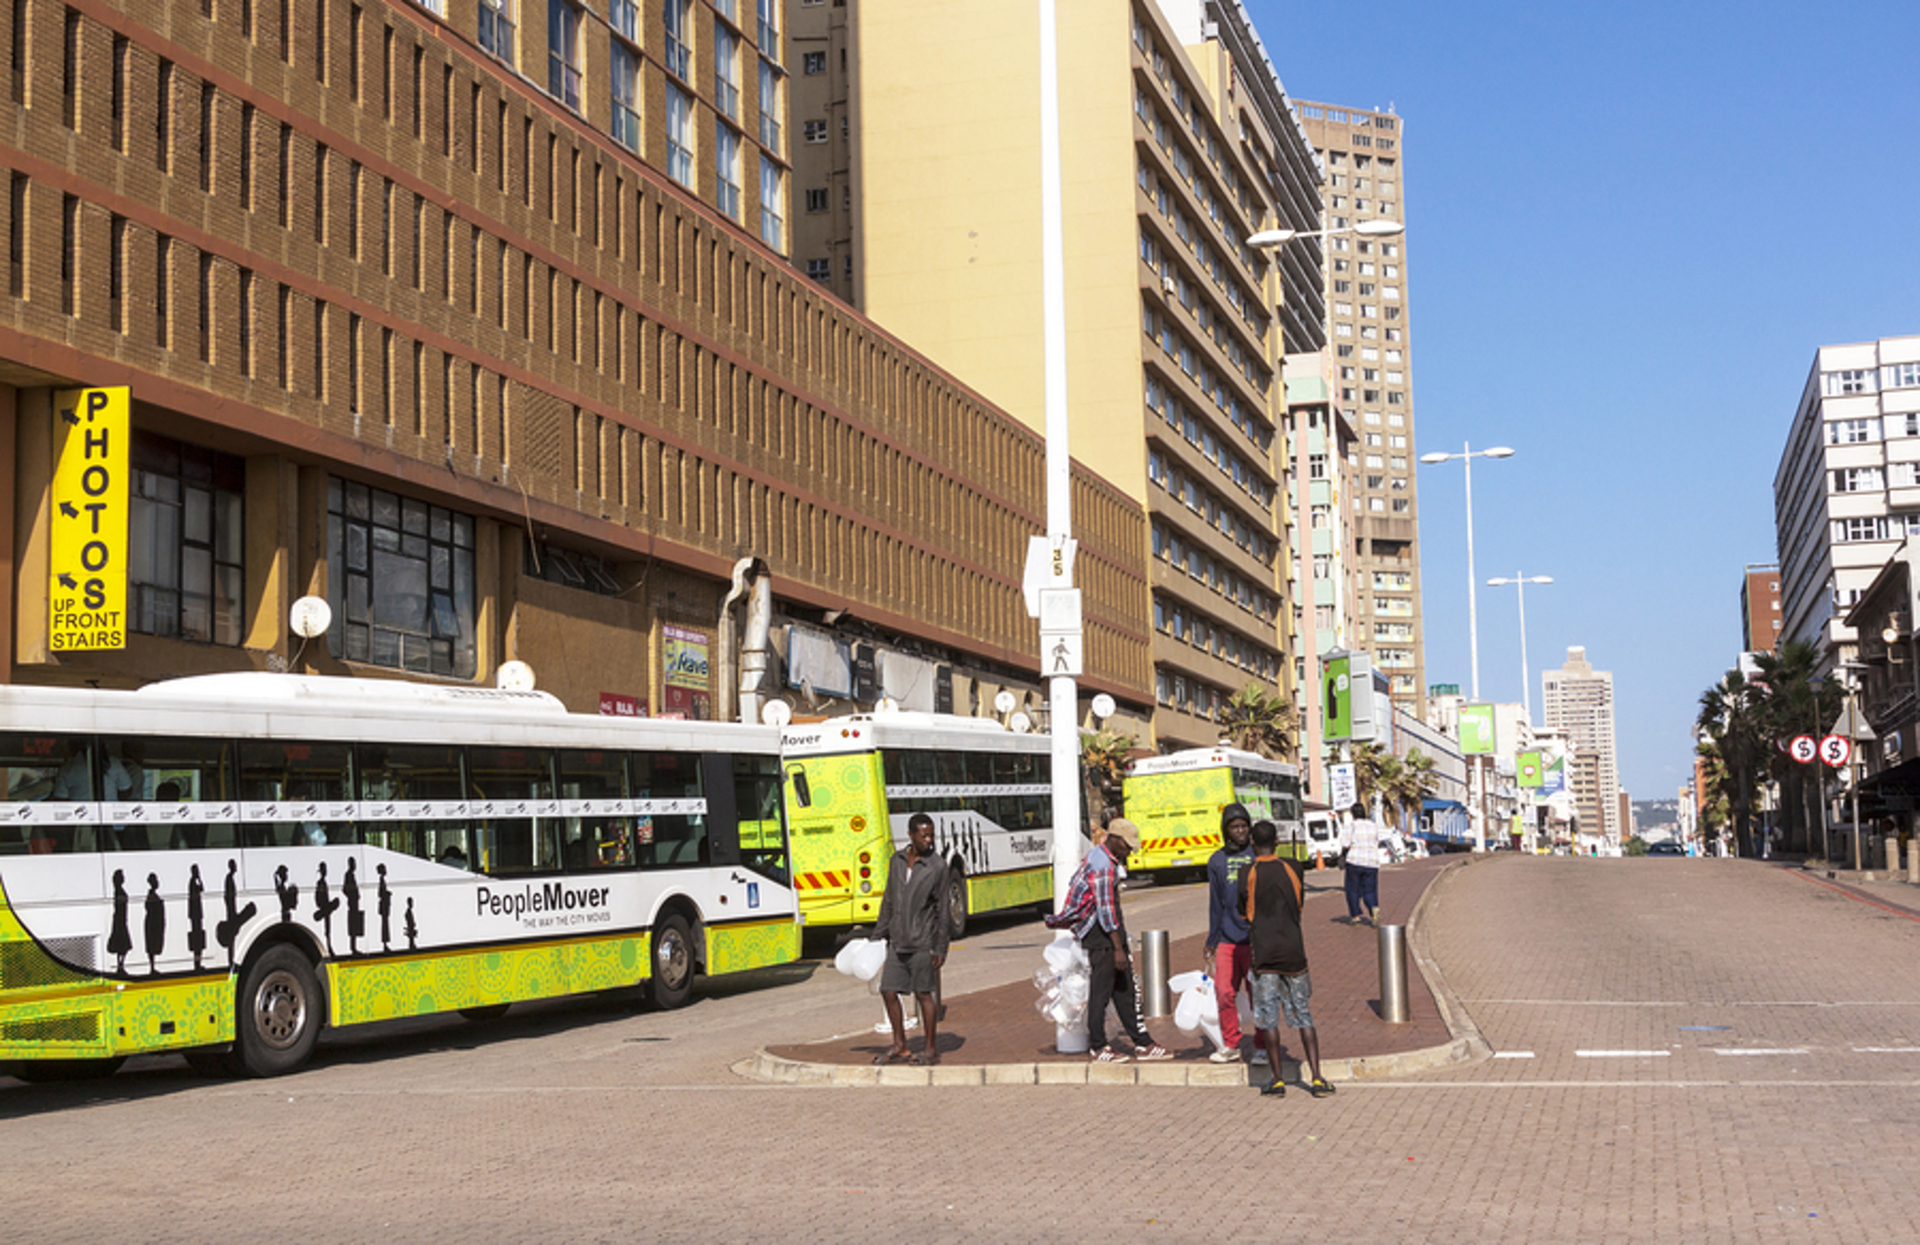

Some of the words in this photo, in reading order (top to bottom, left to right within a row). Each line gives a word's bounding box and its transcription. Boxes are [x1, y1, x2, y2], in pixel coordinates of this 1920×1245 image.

[81, 391, 109, 610] PHOTOS
[53, 599, 75, 612] UP
[54, 612, 120, 629] FRONT
[52, 631, 122, 649] STAIRS
[477, 882, 609, 921] PeopleMover
